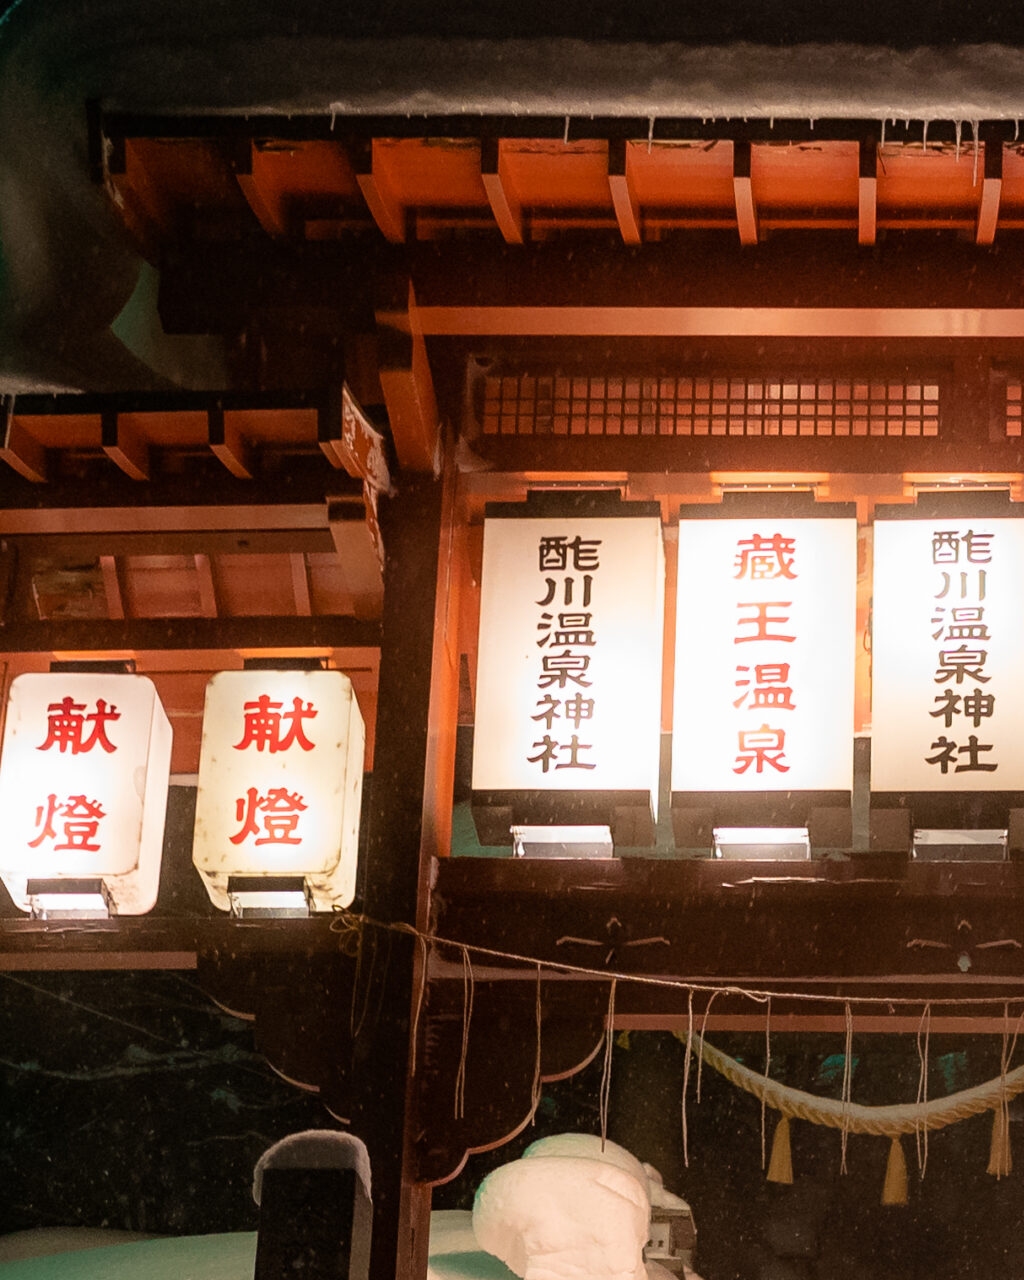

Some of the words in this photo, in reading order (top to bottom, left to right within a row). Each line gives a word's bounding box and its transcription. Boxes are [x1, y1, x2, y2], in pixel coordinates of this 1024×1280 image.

[733, 533, 798, 775] 蔵王温泉
[27, 696, 121, 852] 献燈
[229, 694, 319, 846] 献燈
